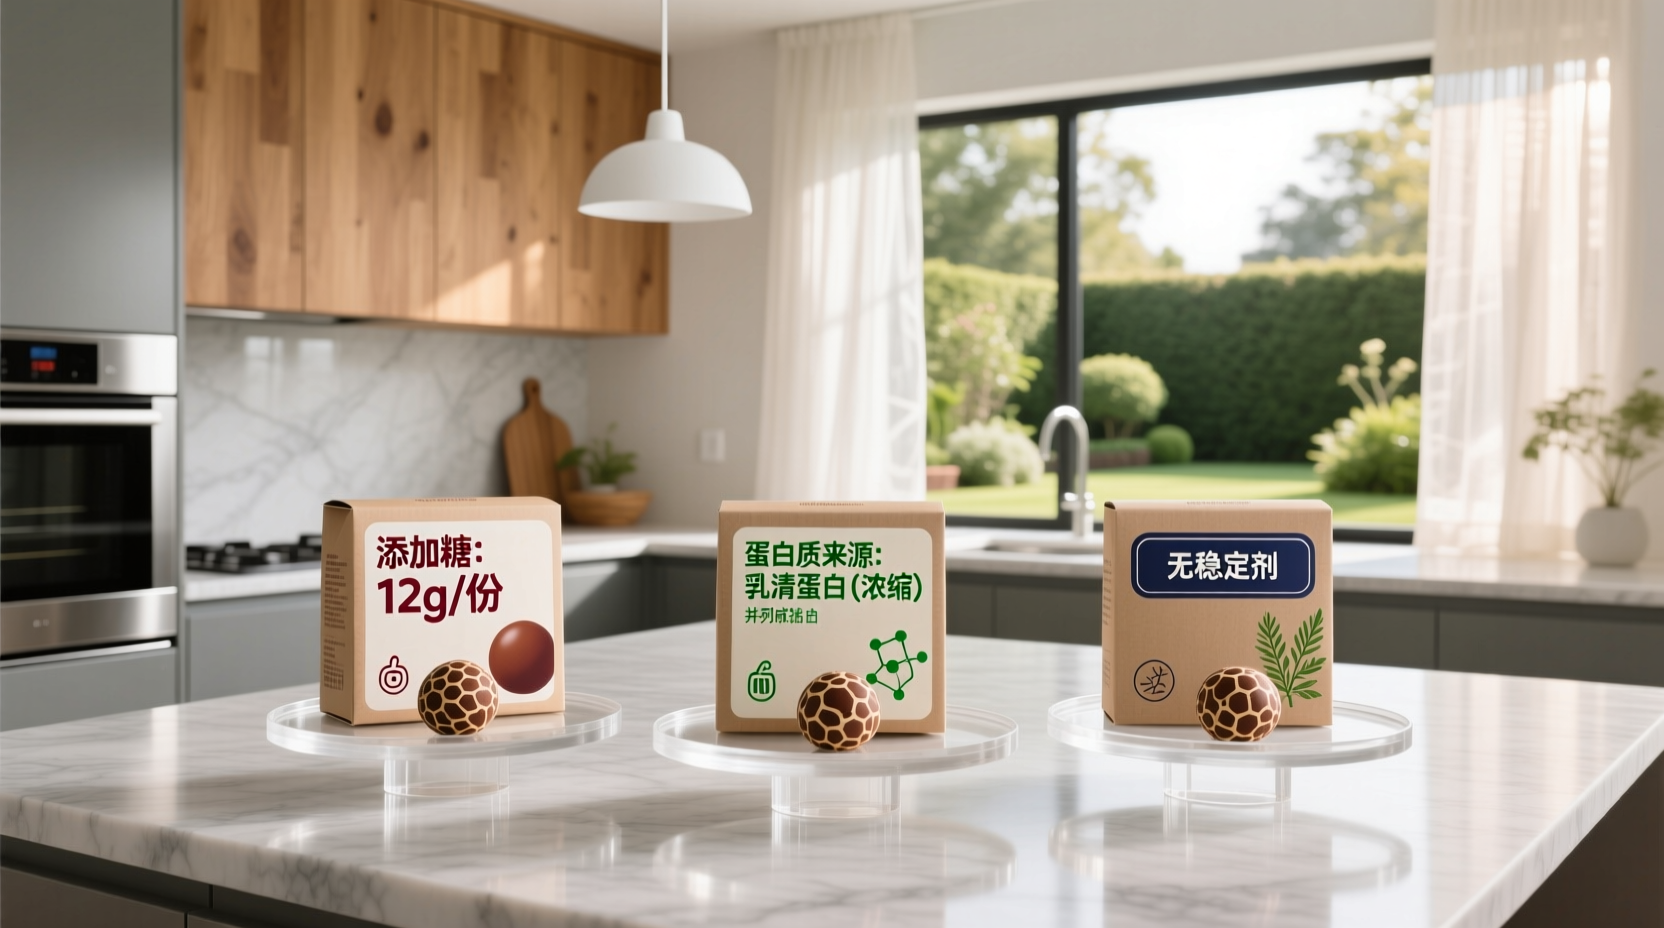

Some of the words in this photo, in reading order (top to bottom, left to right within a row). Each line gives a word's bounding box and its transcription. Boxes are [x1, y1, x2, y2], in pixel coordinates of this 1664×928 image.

[376, 534, 483, 569] 添加糖:
[745, 541, 882, 568] 蛋白质来源:
[1167, 550, 1278, 581] 无稳定剂
[377, 573, 504, 624] 12g/份
[745, 572, 923, 602] 乳清蛋白(浓缩)
